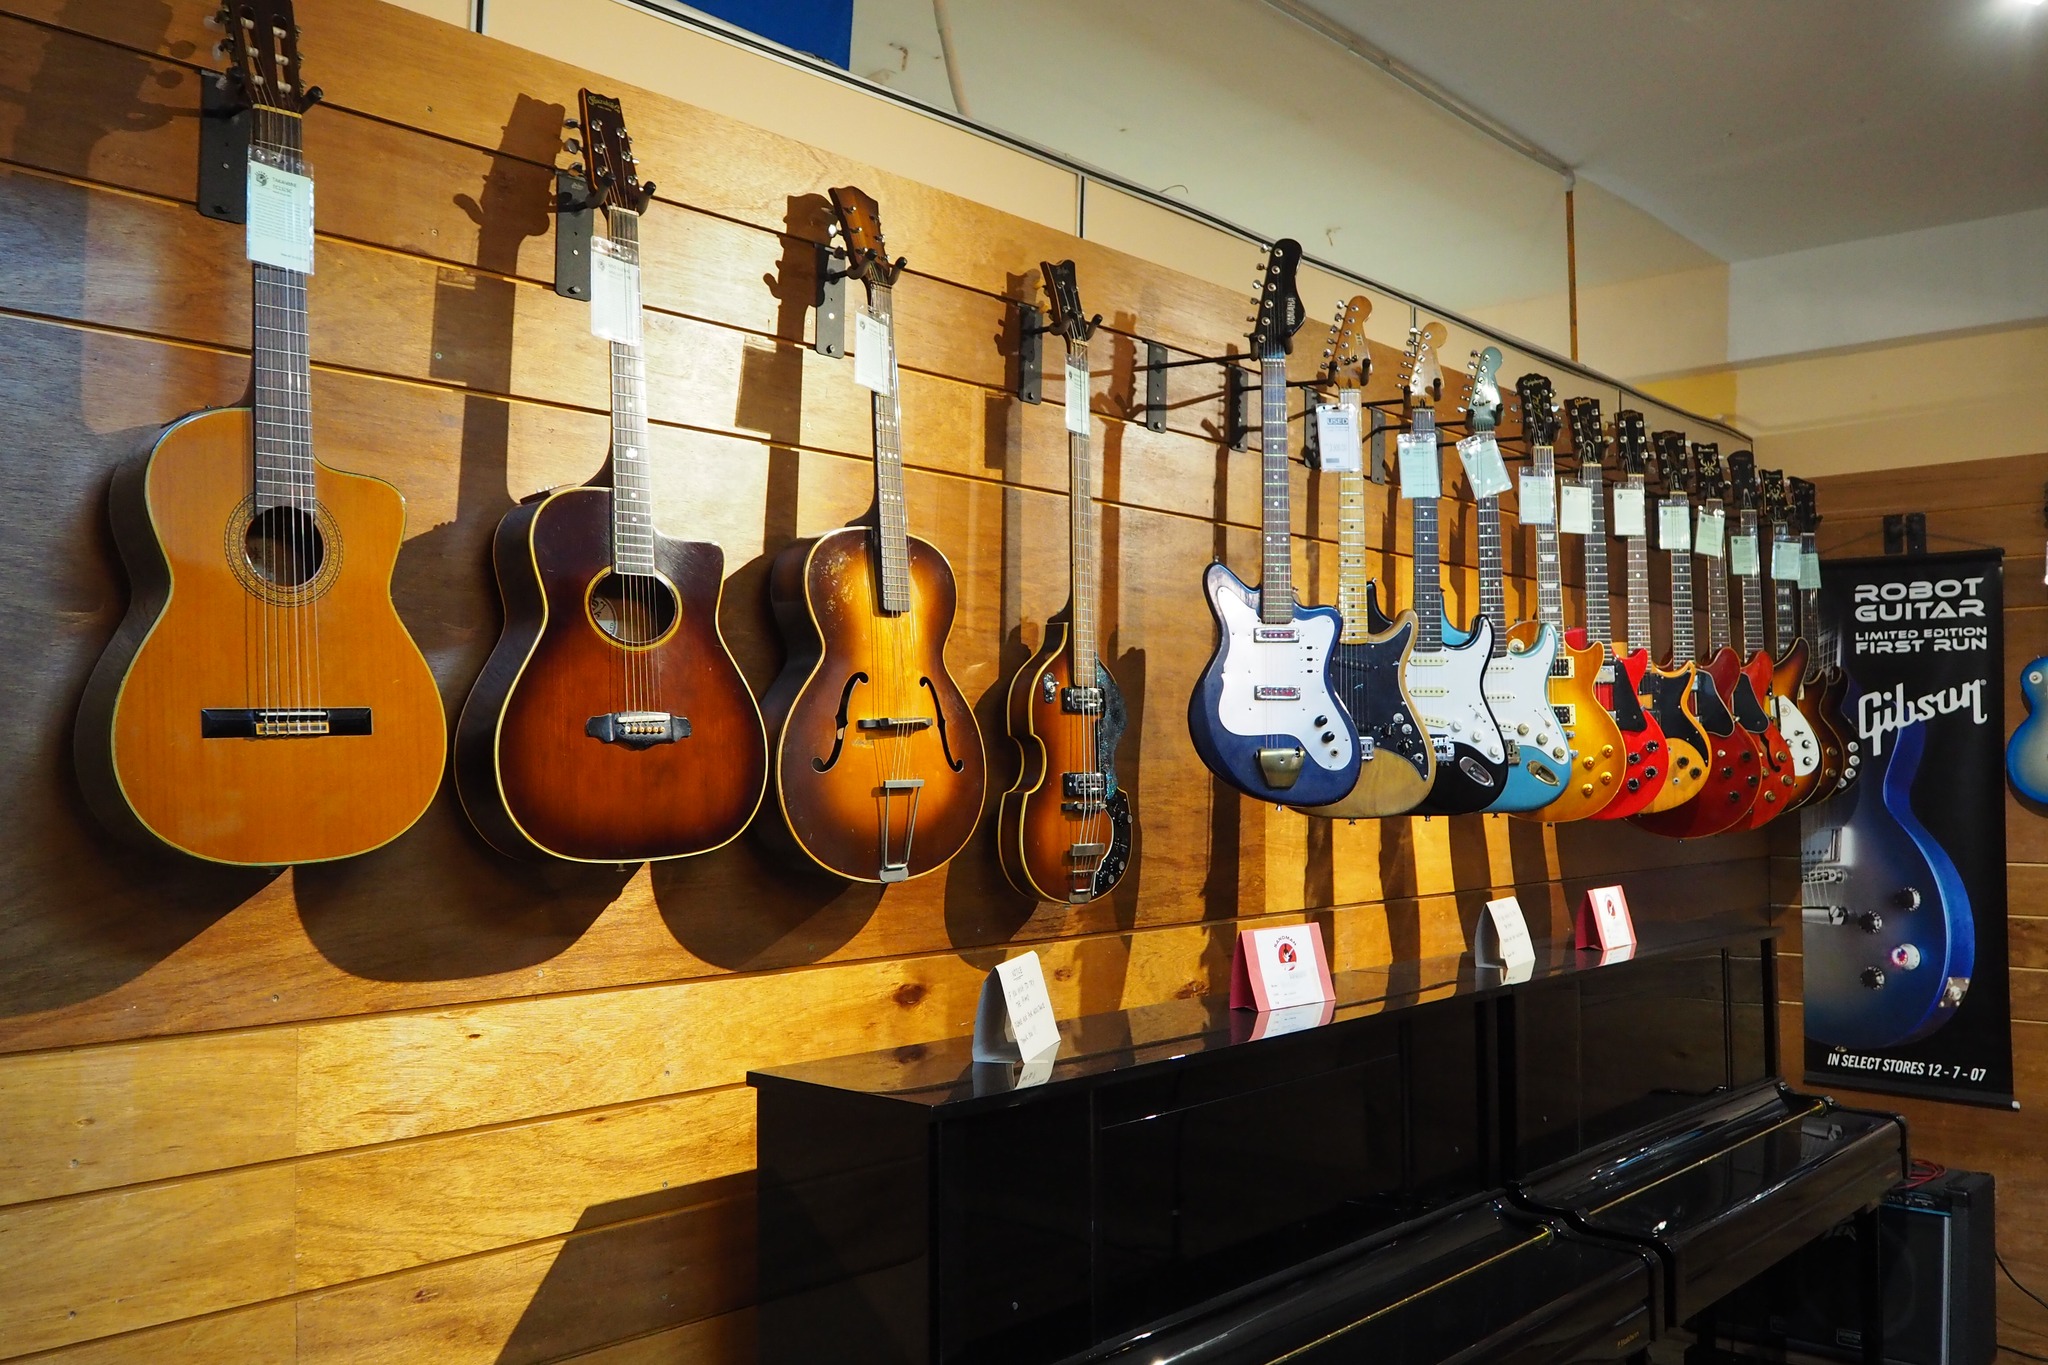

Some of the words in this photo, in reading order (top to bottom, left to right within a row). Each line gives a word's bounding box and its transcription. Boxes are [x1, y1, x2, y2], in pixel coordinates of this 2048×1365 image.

[1286, 297, 1296, 325] YAMAHA
[1854, 577, 1984, 603] ROBOT
[1854, 599, 1986, 622] GUITAR
[1855, 629, 1919, 641] LIMITED
[1923, 627, 1988, 638] EDITION
[1855, 640, 1925, 655] FIRST
[1933, 637, 1987, 652] RUN
[1858, 679, 1988, 757] Gibson
[1827, 1053, 1840, 1066] IN
[1841, 1054, 1881, 1071] SELECT
[1882, 1058, 1925, 1076] STORES
[1928, 1063, 1943, 1077] 12
[1970, 1067, 1987, 1082] 07
